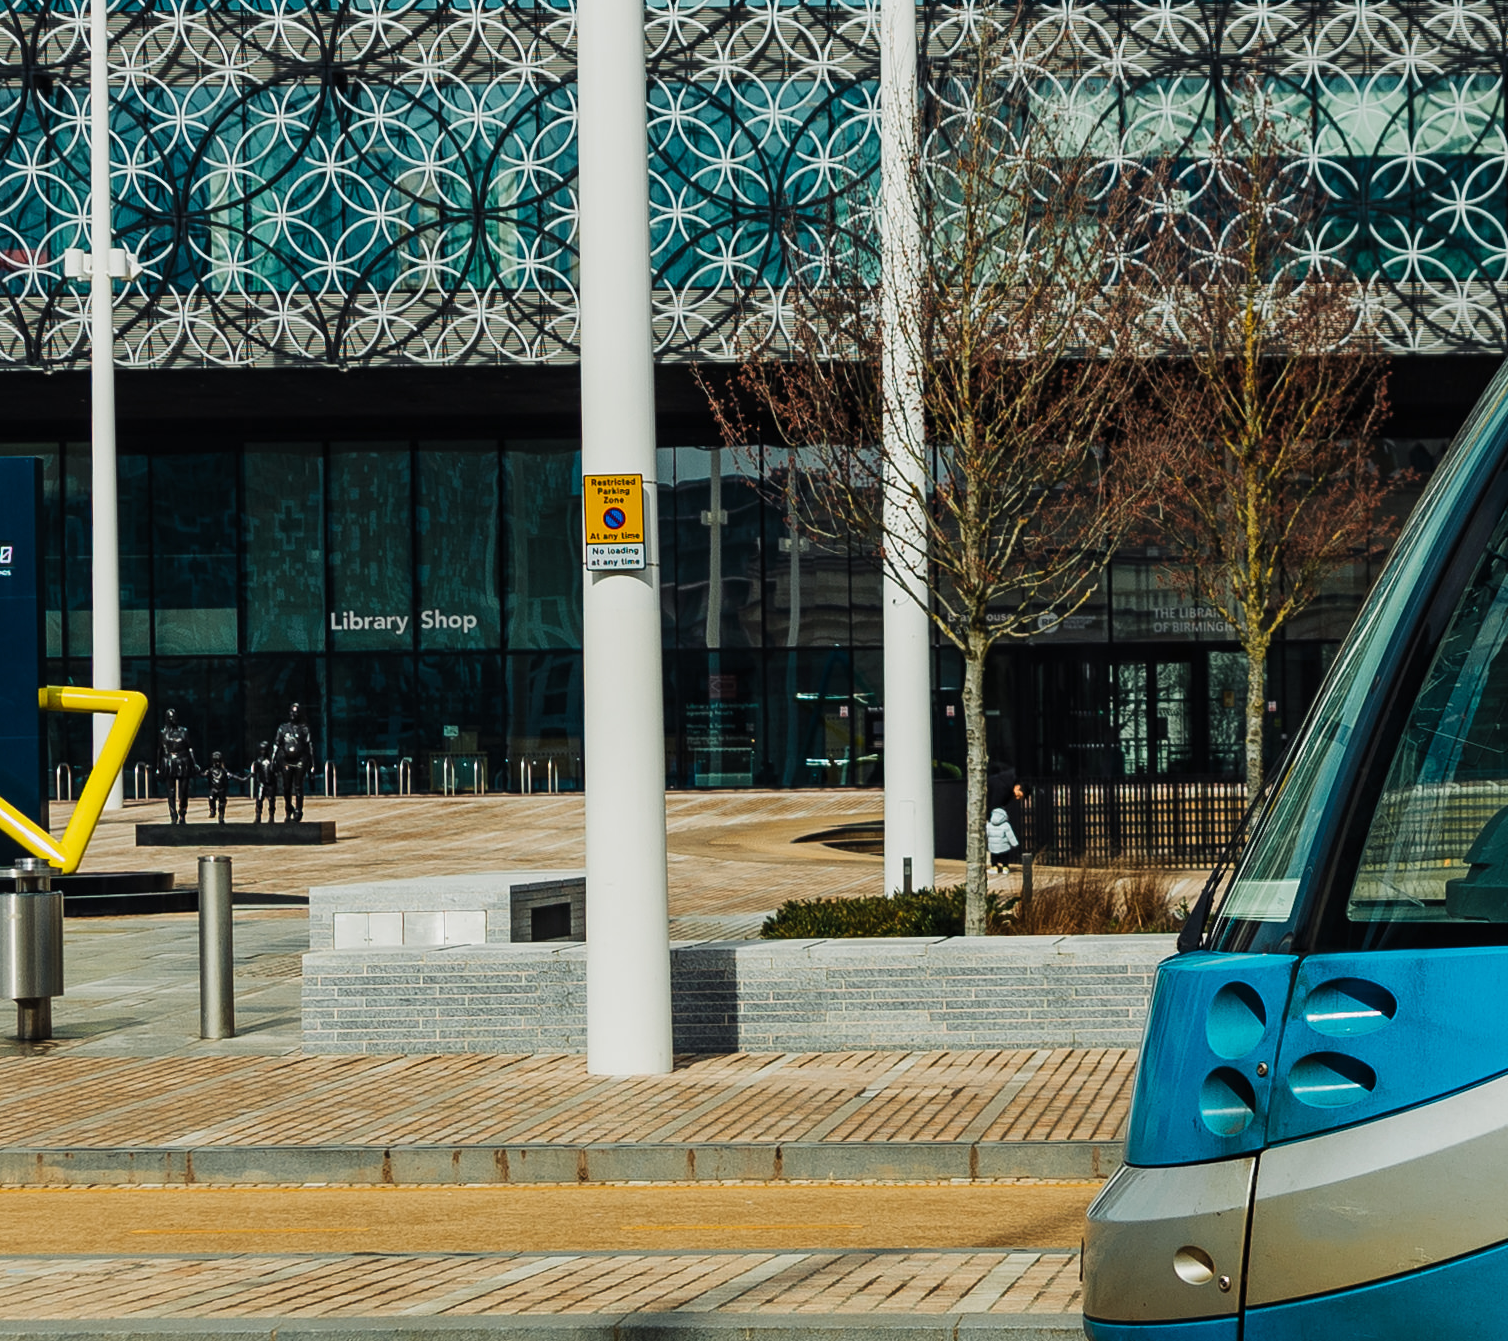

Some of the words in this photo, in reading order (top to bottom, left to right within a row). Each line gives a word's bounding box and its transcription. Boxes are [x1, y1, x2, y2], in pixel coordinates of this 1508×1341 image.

[591, 478, 636, 486] Restricted
[597, 487, 630, 496] Parking
[603, 496, 624, 504] Zone
[590, 532, 600, 540] At
[592, 547, 604, 555] No
[608, 546, 639, 556] loading
[1154, 602, 1176, 619] THE
[330, 610, 409, 635] Library
[421, 609, 478, 633] Shop
[1153, 622, 1170, 633] OF
